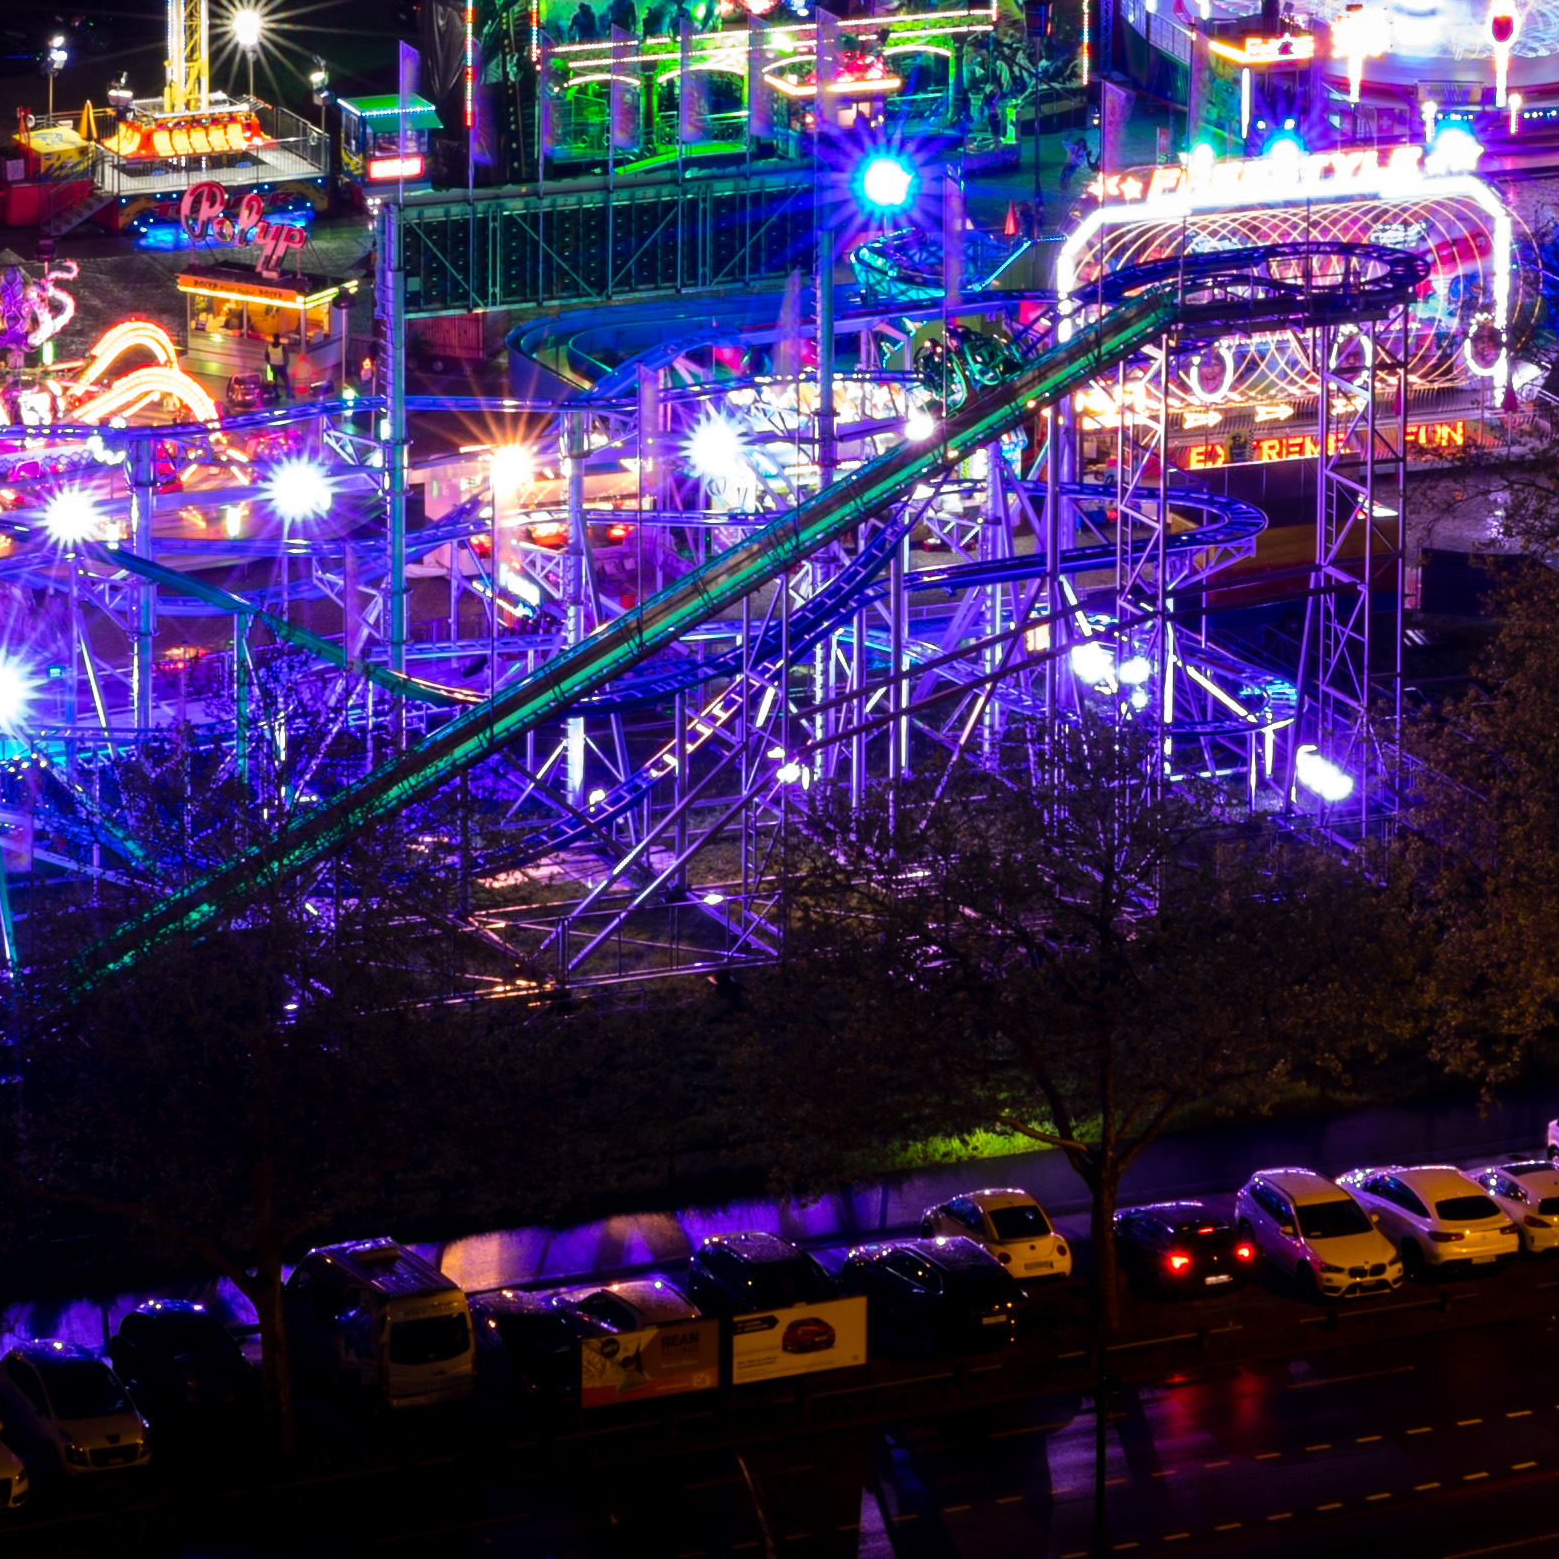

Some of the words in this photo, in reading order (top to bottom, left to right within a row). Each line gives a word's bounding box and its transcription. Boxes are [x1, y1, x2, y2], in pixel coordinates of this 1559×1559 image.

[1148, 145, 1424, 198] FEETYLE
[153, 191, 296, 219] TWR
[1189, 432, 1346, 469] EXREME
[661, 1331, 700, 1348] BEAN
